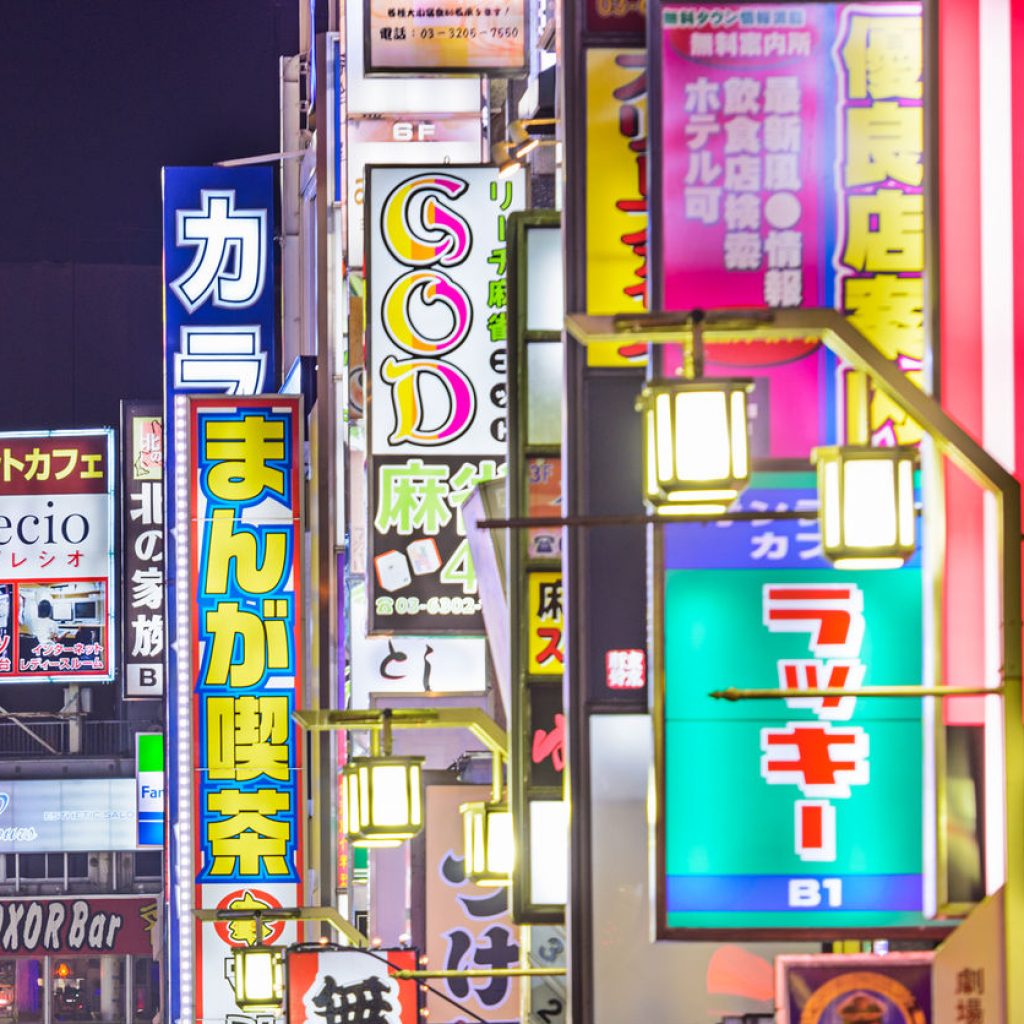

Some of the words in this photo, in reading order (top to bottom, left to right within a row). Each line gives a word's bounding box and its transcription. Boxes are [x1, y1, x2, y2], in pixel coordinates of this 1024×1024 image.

[392, 123, 436, 140] 6F
[204, 415, 292, 877] まんが喫茶
[760, 583, 870, 862] ラッキー
[787, 879, 843, 907] B1
[69, 901, 122, 949] Bar
